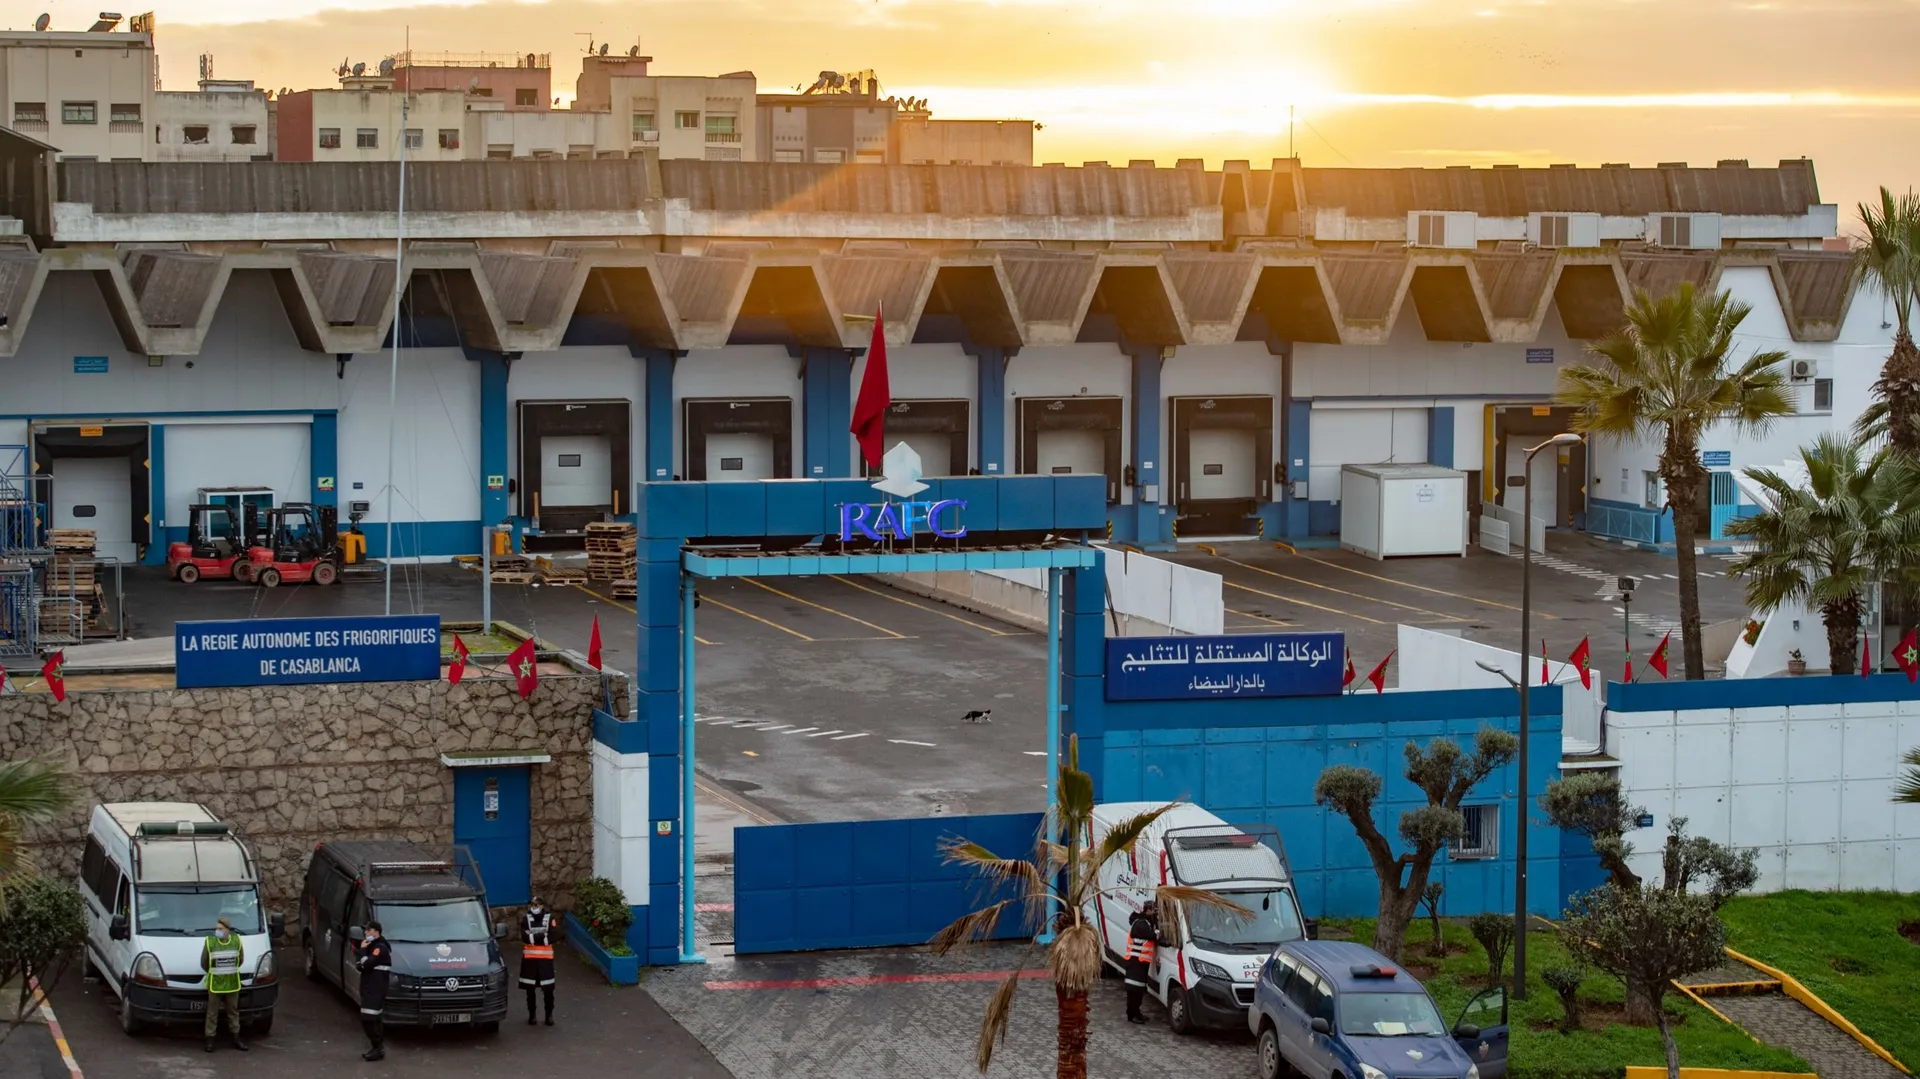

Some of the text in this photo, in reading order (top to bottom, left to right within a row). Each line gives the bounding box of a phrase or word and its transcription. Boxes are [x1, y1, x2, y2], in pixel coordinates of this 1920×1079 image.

[840, 499, 968, 541] RAFC
[181, 628, 436, 651] LA REGIE AUTONOME DES FRIGORIFIQUES
[260, 657, 360, 675] DE CASABLANCA
[1121, 641, 1331, 673] الوكالة المستقلة للتثليج
